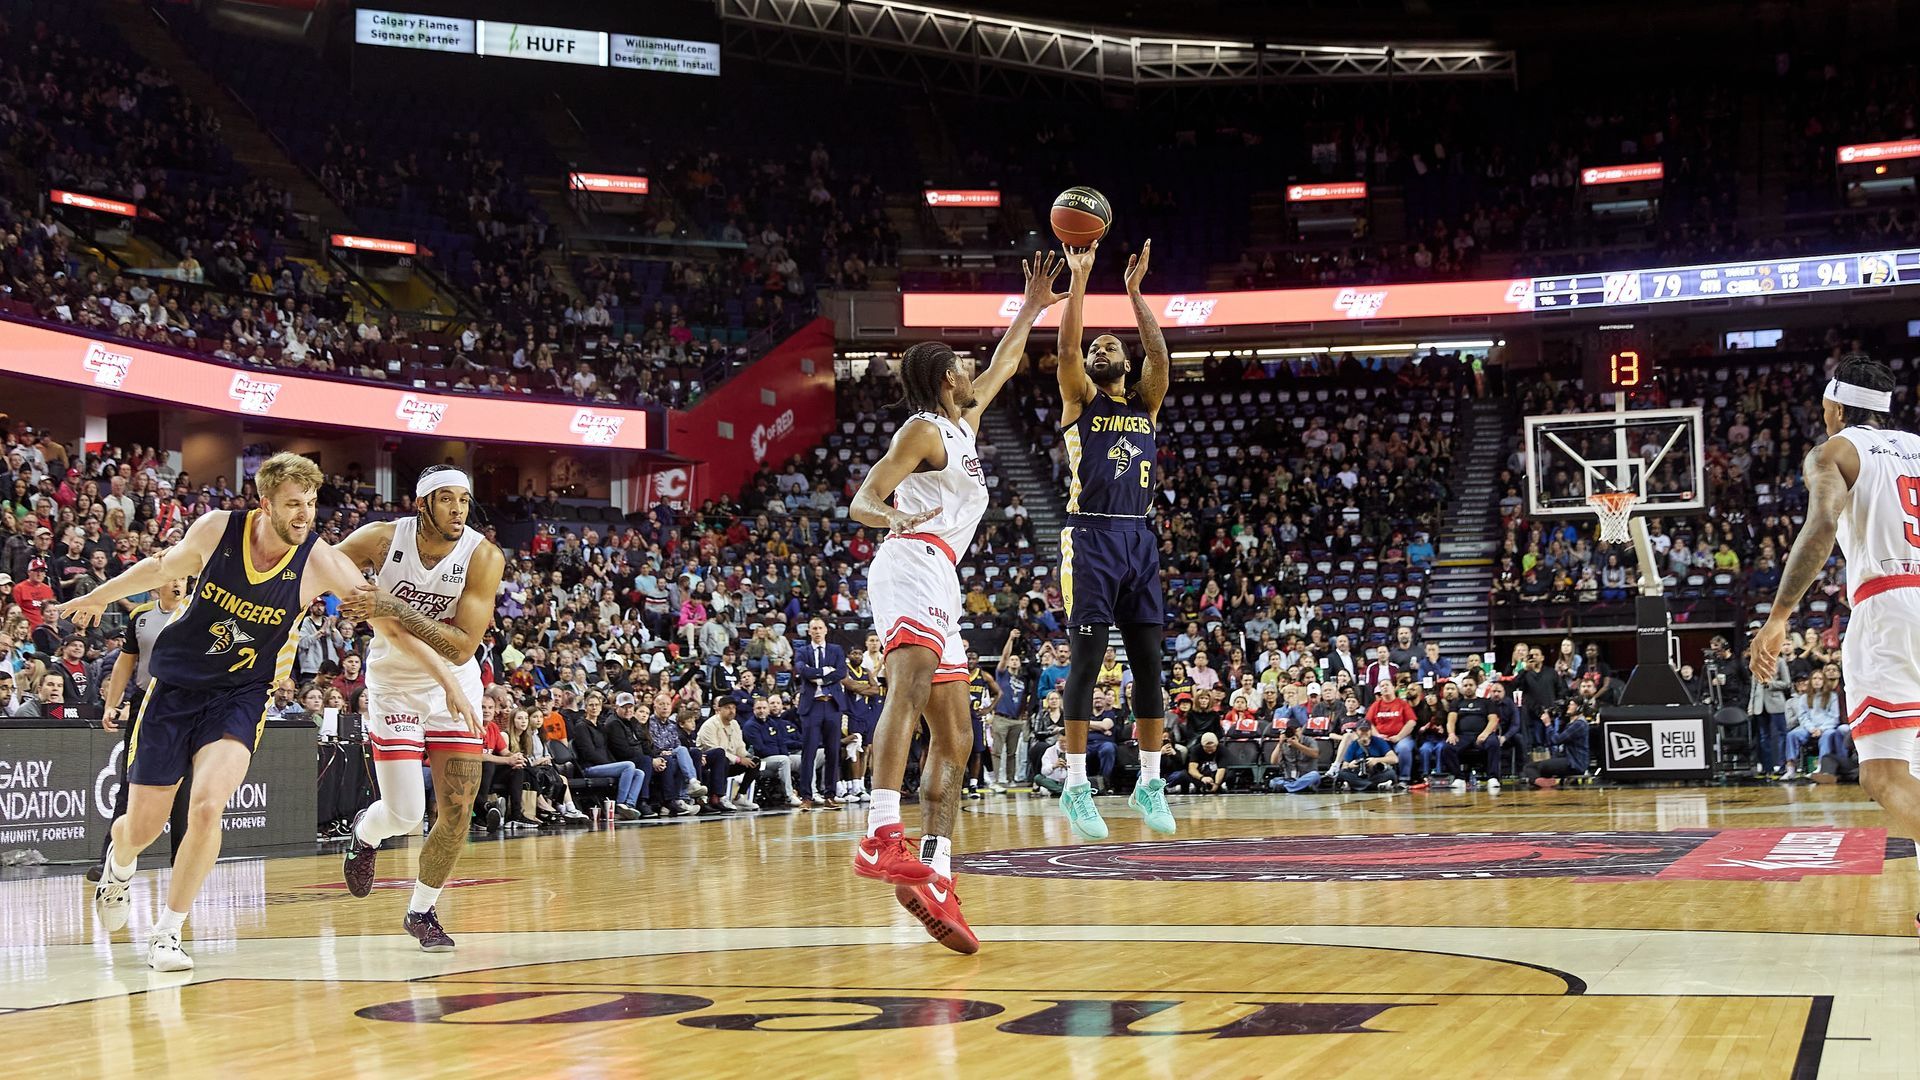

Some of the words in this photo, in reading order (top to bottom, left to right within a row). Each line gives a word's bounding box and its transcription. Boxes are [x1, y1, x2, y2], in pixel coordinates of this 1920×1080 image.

[372, 15, 416, 30] Calgary
[418, 19, 460, 32] Flames
[370, 29, 415, 43] Signage
[417, 33, 461, 46] Partner
[526, 36, 576, 54] HUFF
[625, 38, 707, 54] WilliamHuff.com
[615, 53, 650, 65] Design.
[653, 57, 680, 68] Print.
[683, 59, 716, 71] Install.
[1781, 273, 1799, 289] 13
[1817, 262, 1848, 286] 94
[1569, 279, 1577, 290] 4
[1653, 274, 1682, 298] 79
[1570, 294, 1578, 305] 2
[1611, 351, 1639, 386] 13
[767, 424, 776, 440] OF
[776, 409, 793, 435] RED
[1091, 415, 1151, 435] STINGERS
[1139, 460, 1152, 489] 6
[201, 582, 287, 625] STINGERS
[64, 707, 79, 718] POSS.
[1661, 731, 1696, 745] NEW
[1662, 745, 1696, 758] ERA
[0, 760, 52, 789] GARY
[231, 816, 266, 829] FOREVER
[42, 826, 86, 841] FOREVER
[354, 991, 1437, 1039] neo
